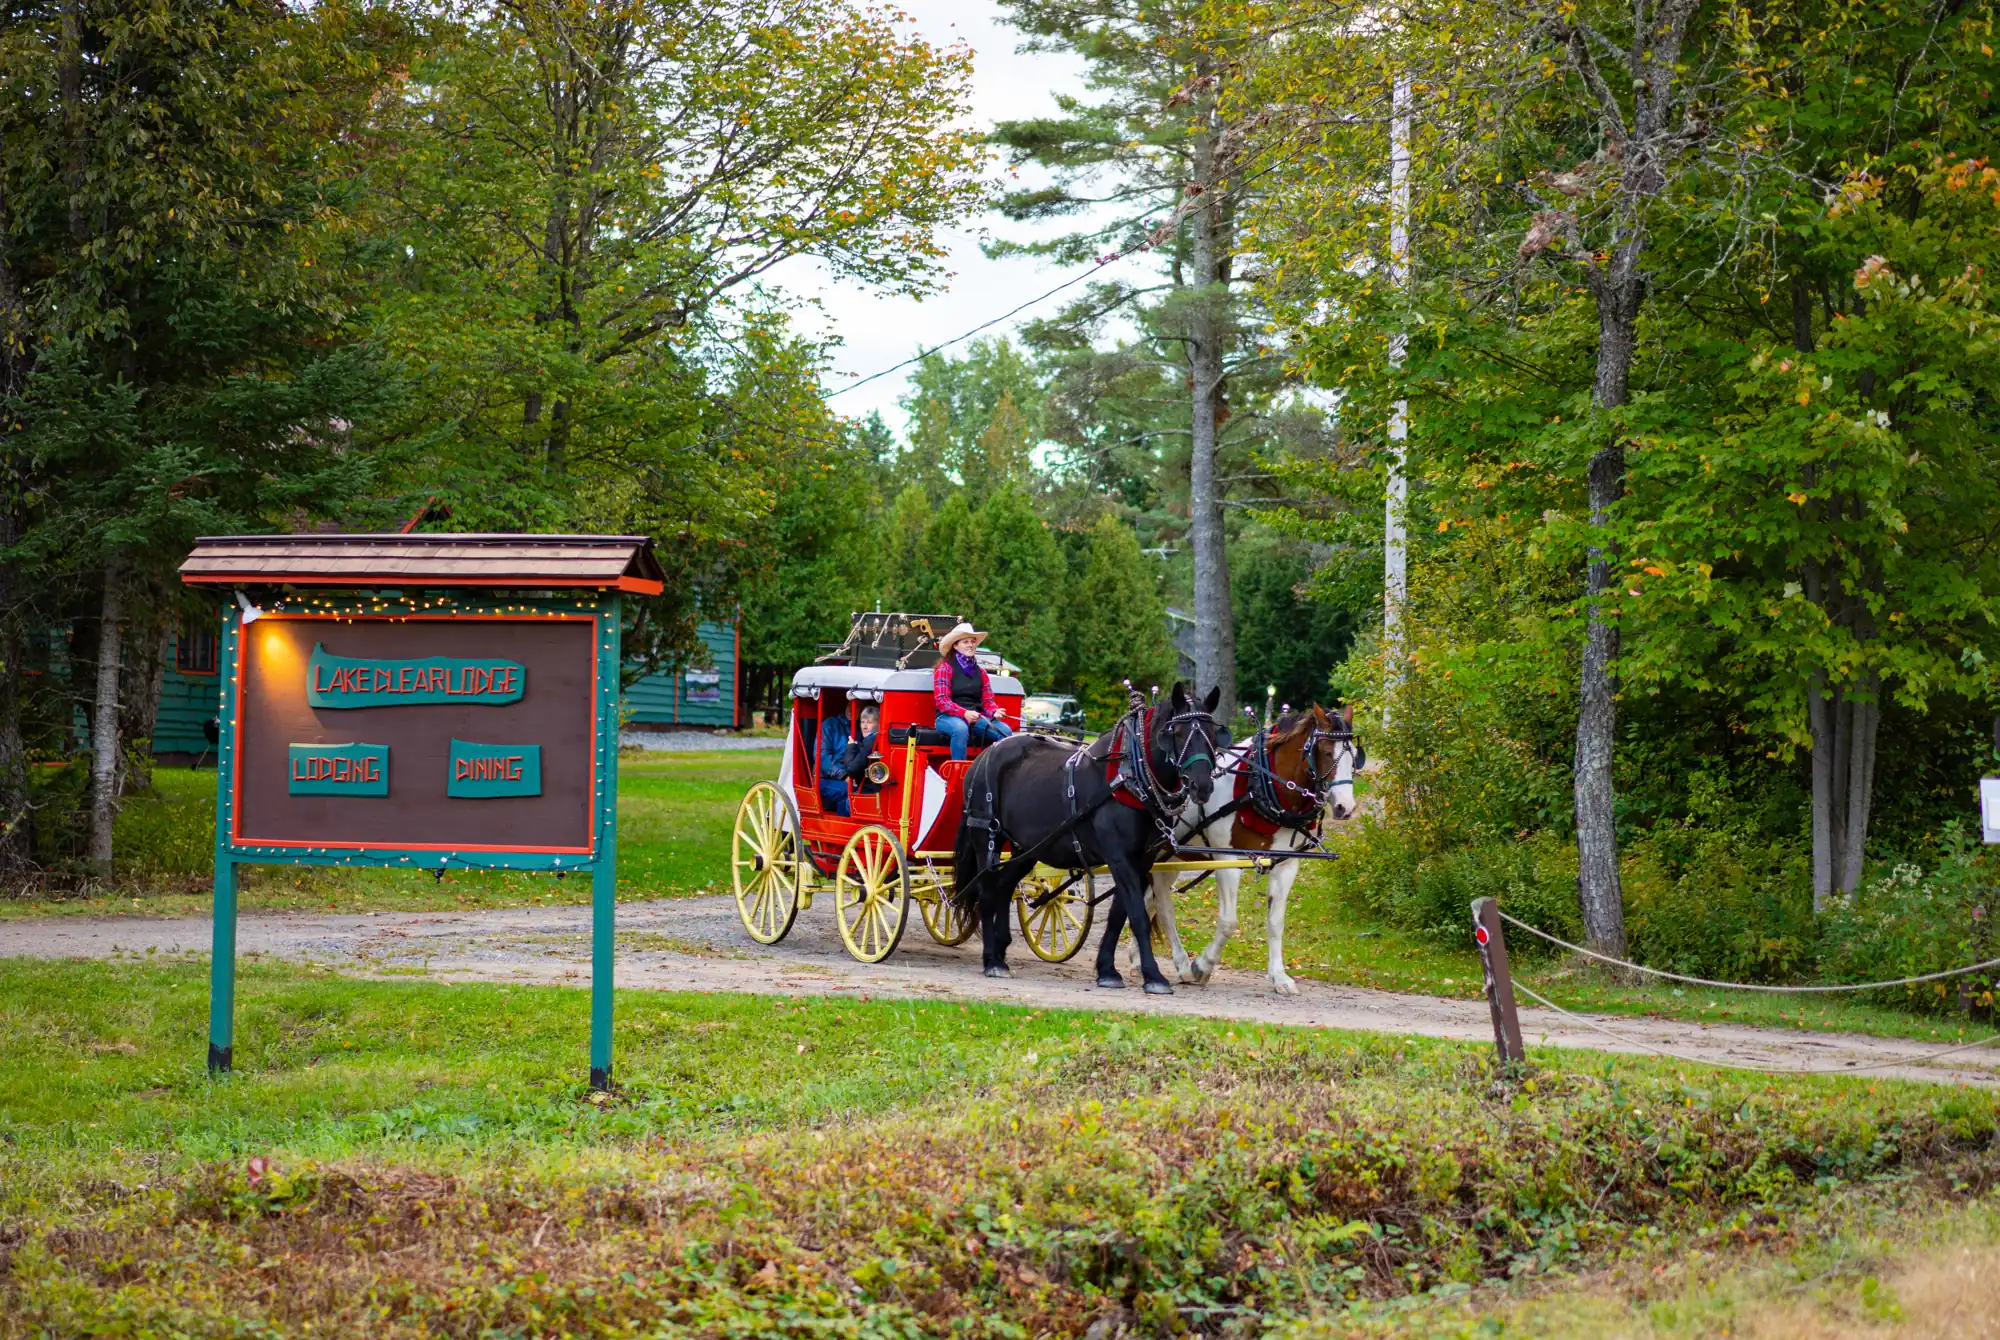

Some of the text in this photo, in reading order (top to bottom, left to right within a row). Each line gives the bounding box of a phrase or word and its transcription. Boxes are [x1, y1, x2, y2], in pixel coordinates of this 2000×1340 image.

[313, 664, 370, 693] LAKE
[445, 666, 518, 695] LODGE
[292, 756, 380, 783] LODGING
[455, 755, 523, 781] DINING
